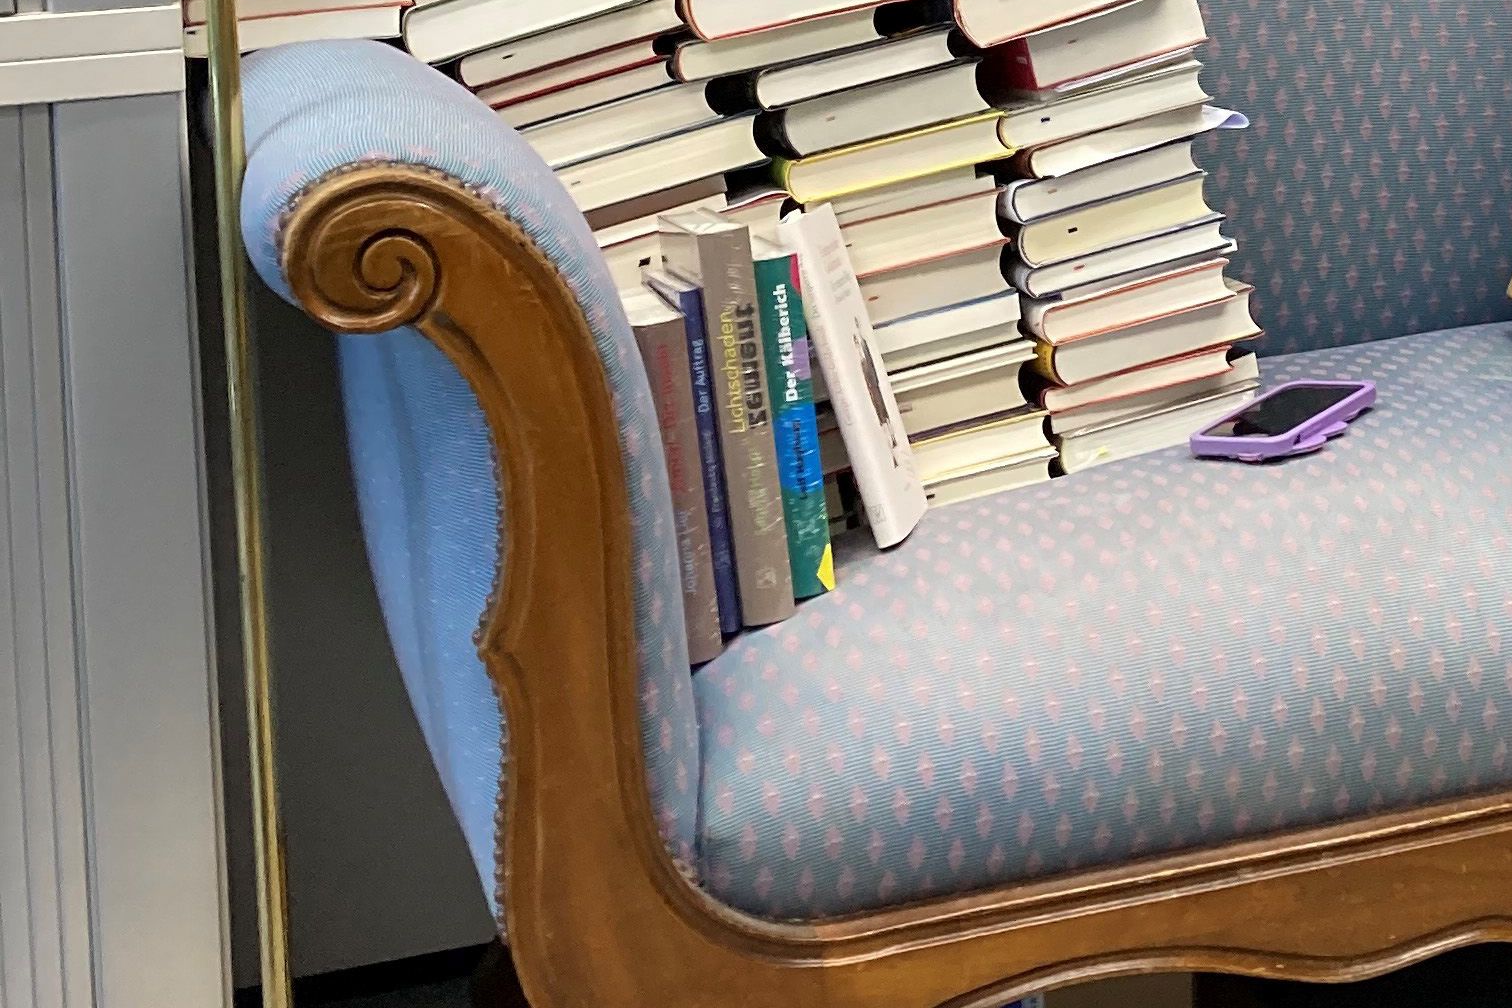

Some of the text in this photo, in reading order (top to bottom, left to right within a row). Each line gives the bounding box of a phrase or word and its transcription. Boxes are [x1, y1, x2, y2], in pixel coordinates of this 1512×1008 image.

[691, 338, 706, 387] Auftrag
[716, 310, 746, 433] Lichtschaden
[773, 283, 799, 403] Der Kälberich
